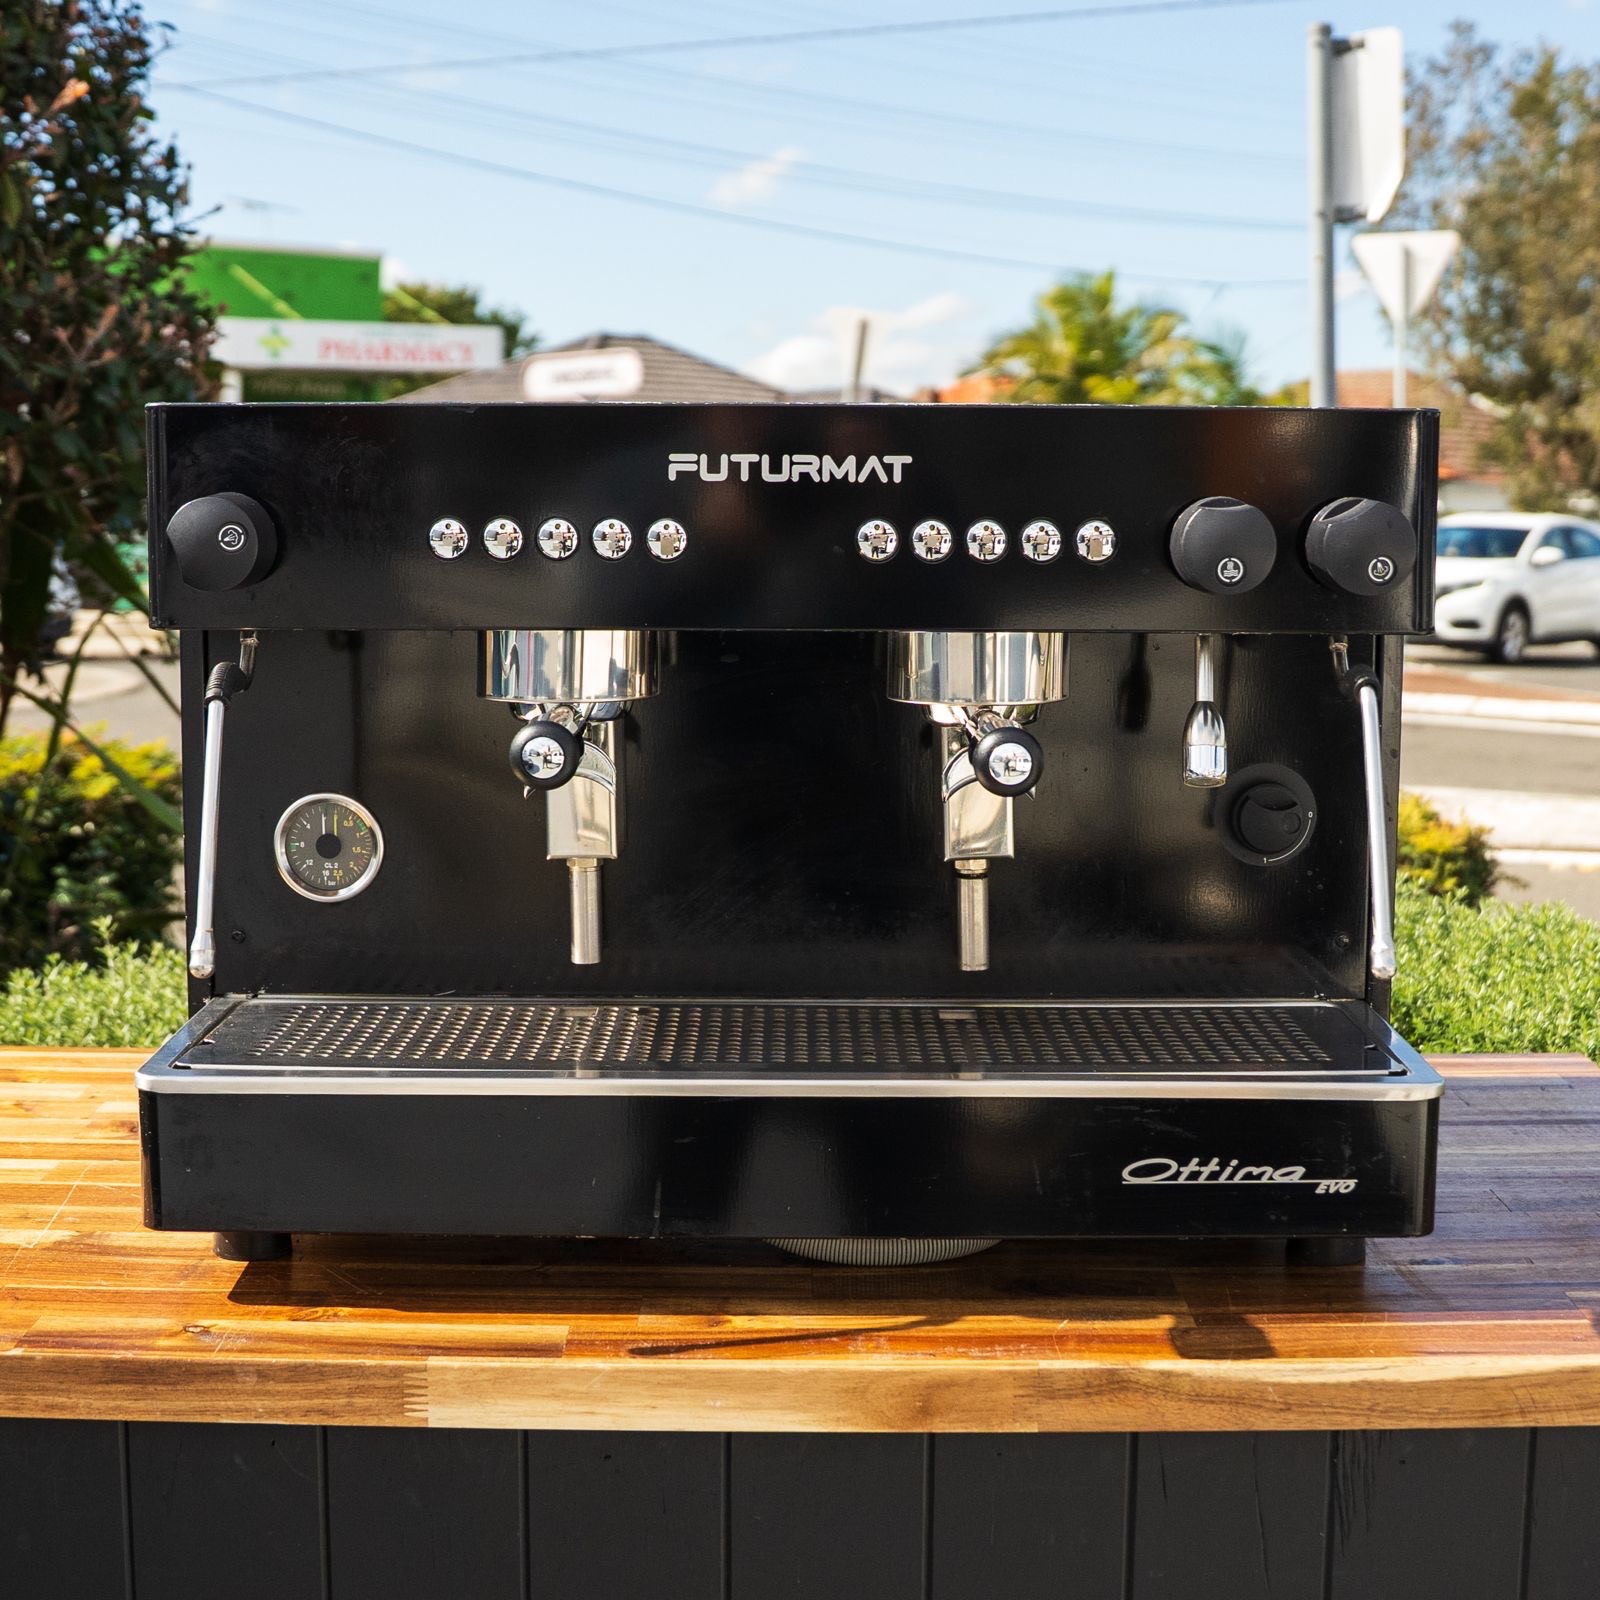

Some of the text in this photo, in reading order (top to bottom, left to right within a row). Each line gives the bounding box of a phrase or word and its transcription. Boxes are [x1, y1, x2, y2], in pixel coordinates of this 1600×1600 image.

[318, 337, 475, 363] PHARMACY
[668, 453, 913, 483] FUTURMAT
[1121, 1157, 1306, 1183] Ottima
[1315, 1181, 1356, 1194] EVO
